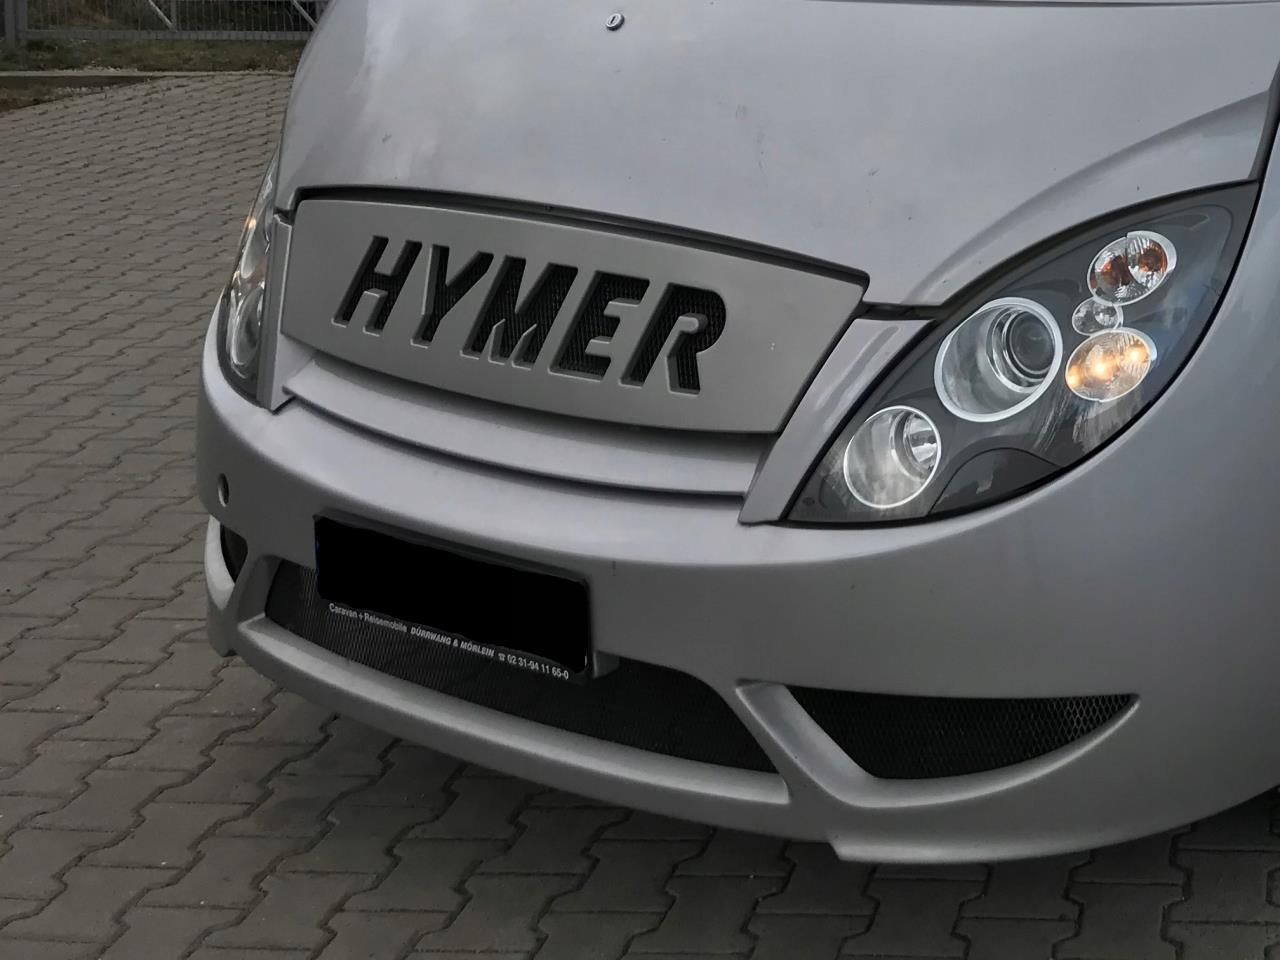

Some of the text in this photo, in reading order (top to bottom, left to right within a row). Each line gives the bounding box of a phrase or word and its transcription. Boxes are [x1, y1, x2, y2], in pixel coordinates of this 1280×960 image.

[330, 235, 727, 396] HYMER
[329, 602, 358, 619] Caravan
[364, 612, 407, 633] Reisemobile
